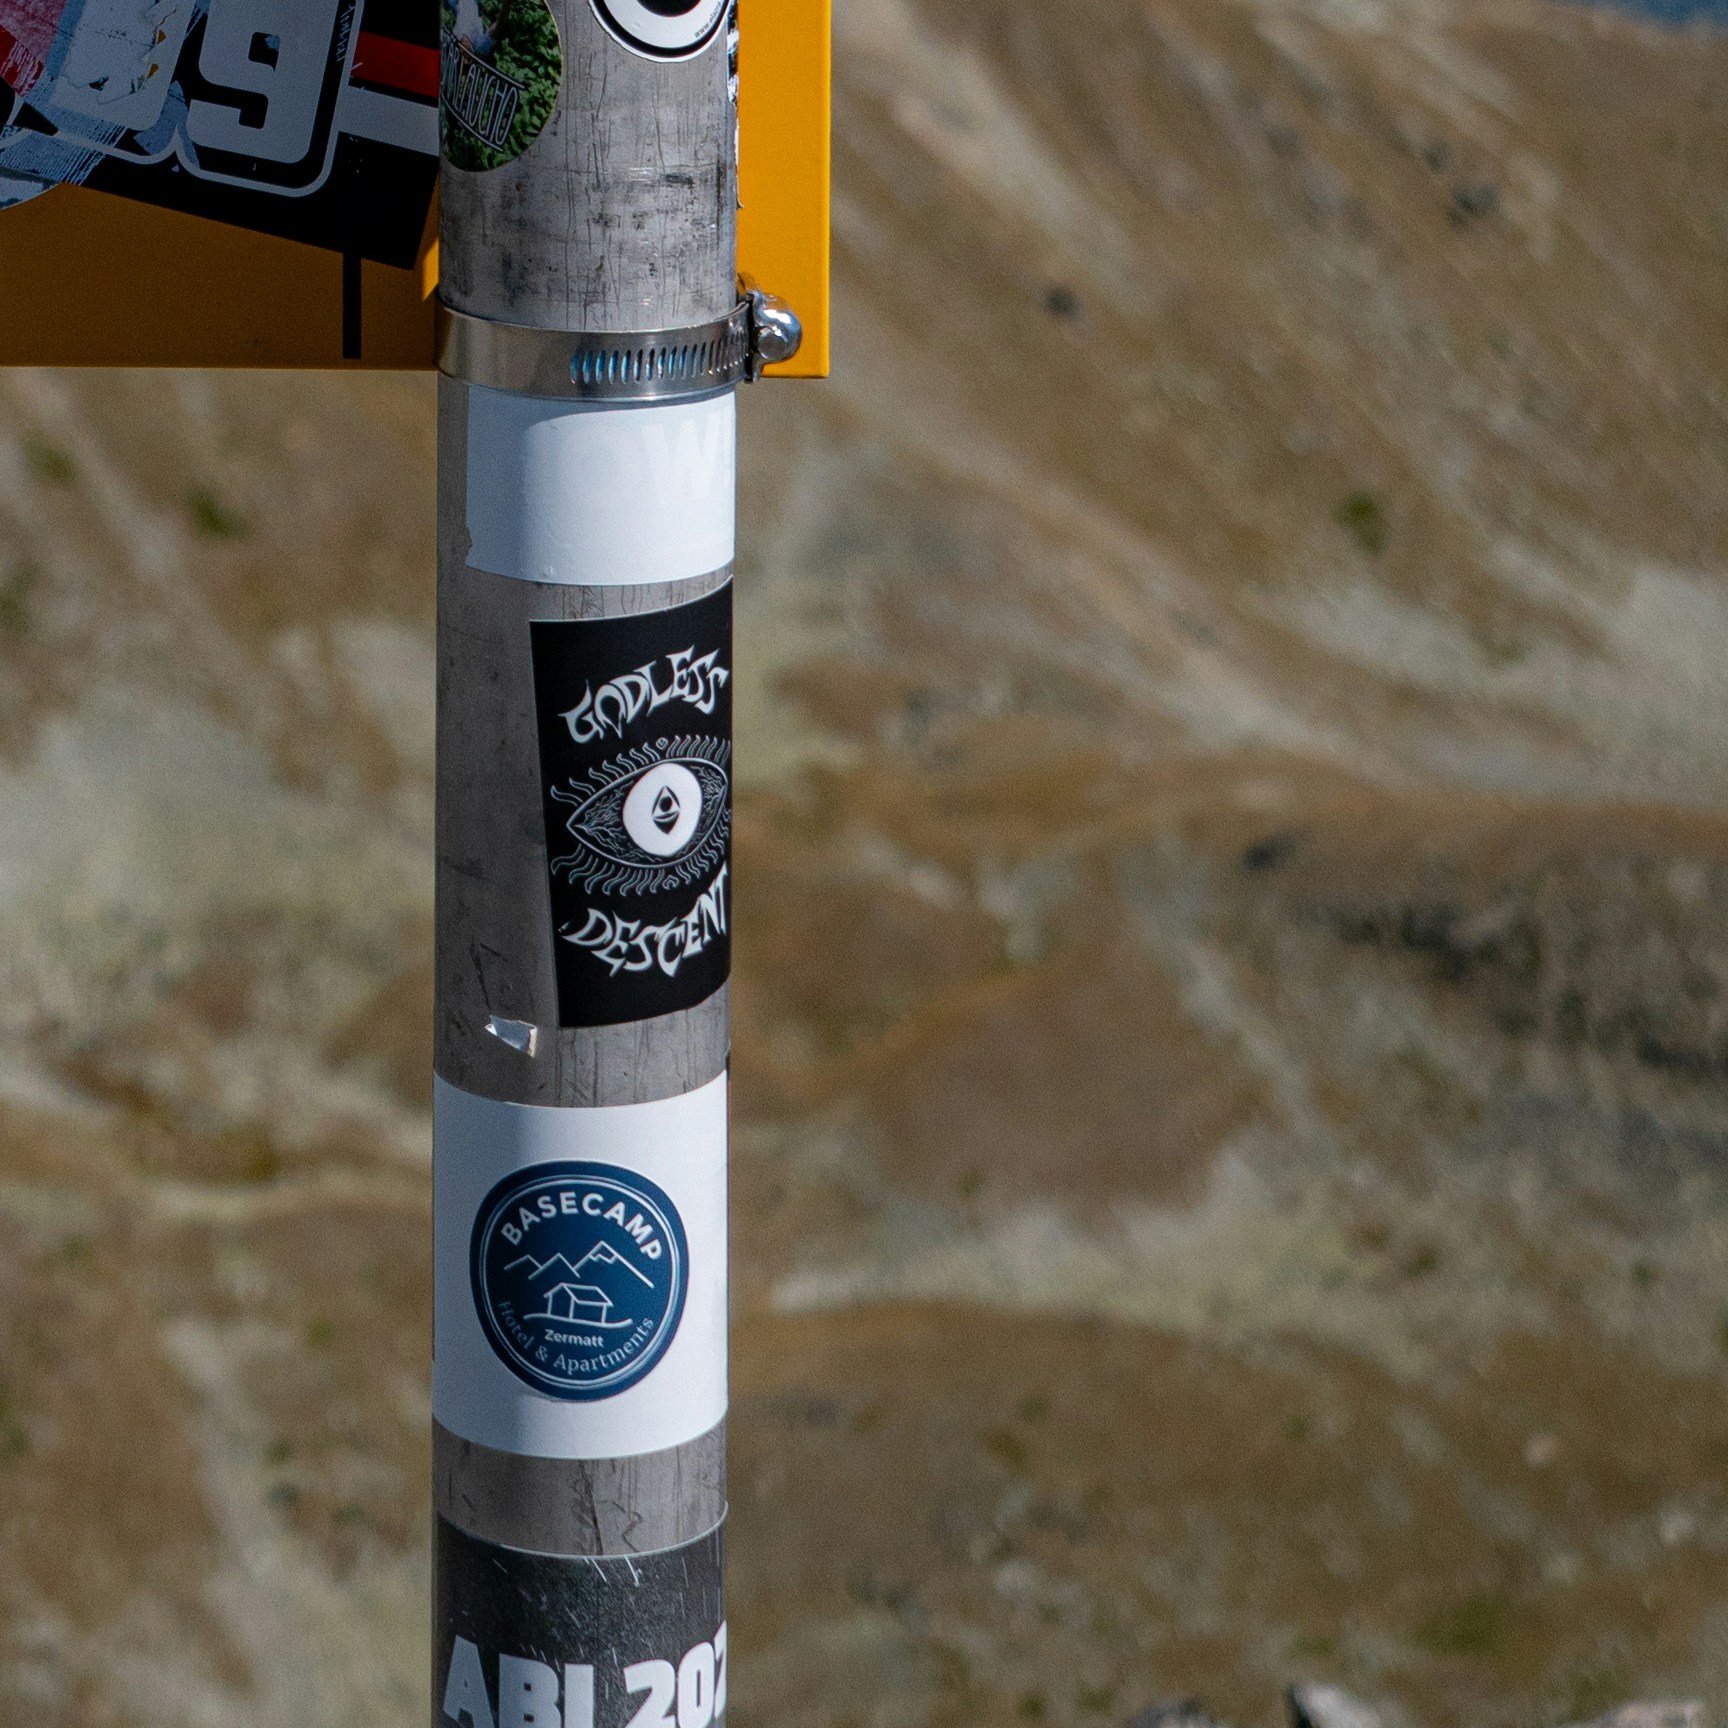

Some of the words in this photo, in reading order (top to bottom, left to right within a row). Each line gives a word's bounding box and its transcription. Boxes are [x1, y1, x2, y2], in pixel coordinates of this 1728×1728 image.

[500, 1190, 663, 1262] BASECAMP
[497, 1300, 535, 1350] Hotel
[534, 1345, 549, 1363] &
[552, 1316, 656, 1376] Apartments
[544, 1328, 605, 1348] Zermatt
[442, 1634, 595, 1728] ABI
